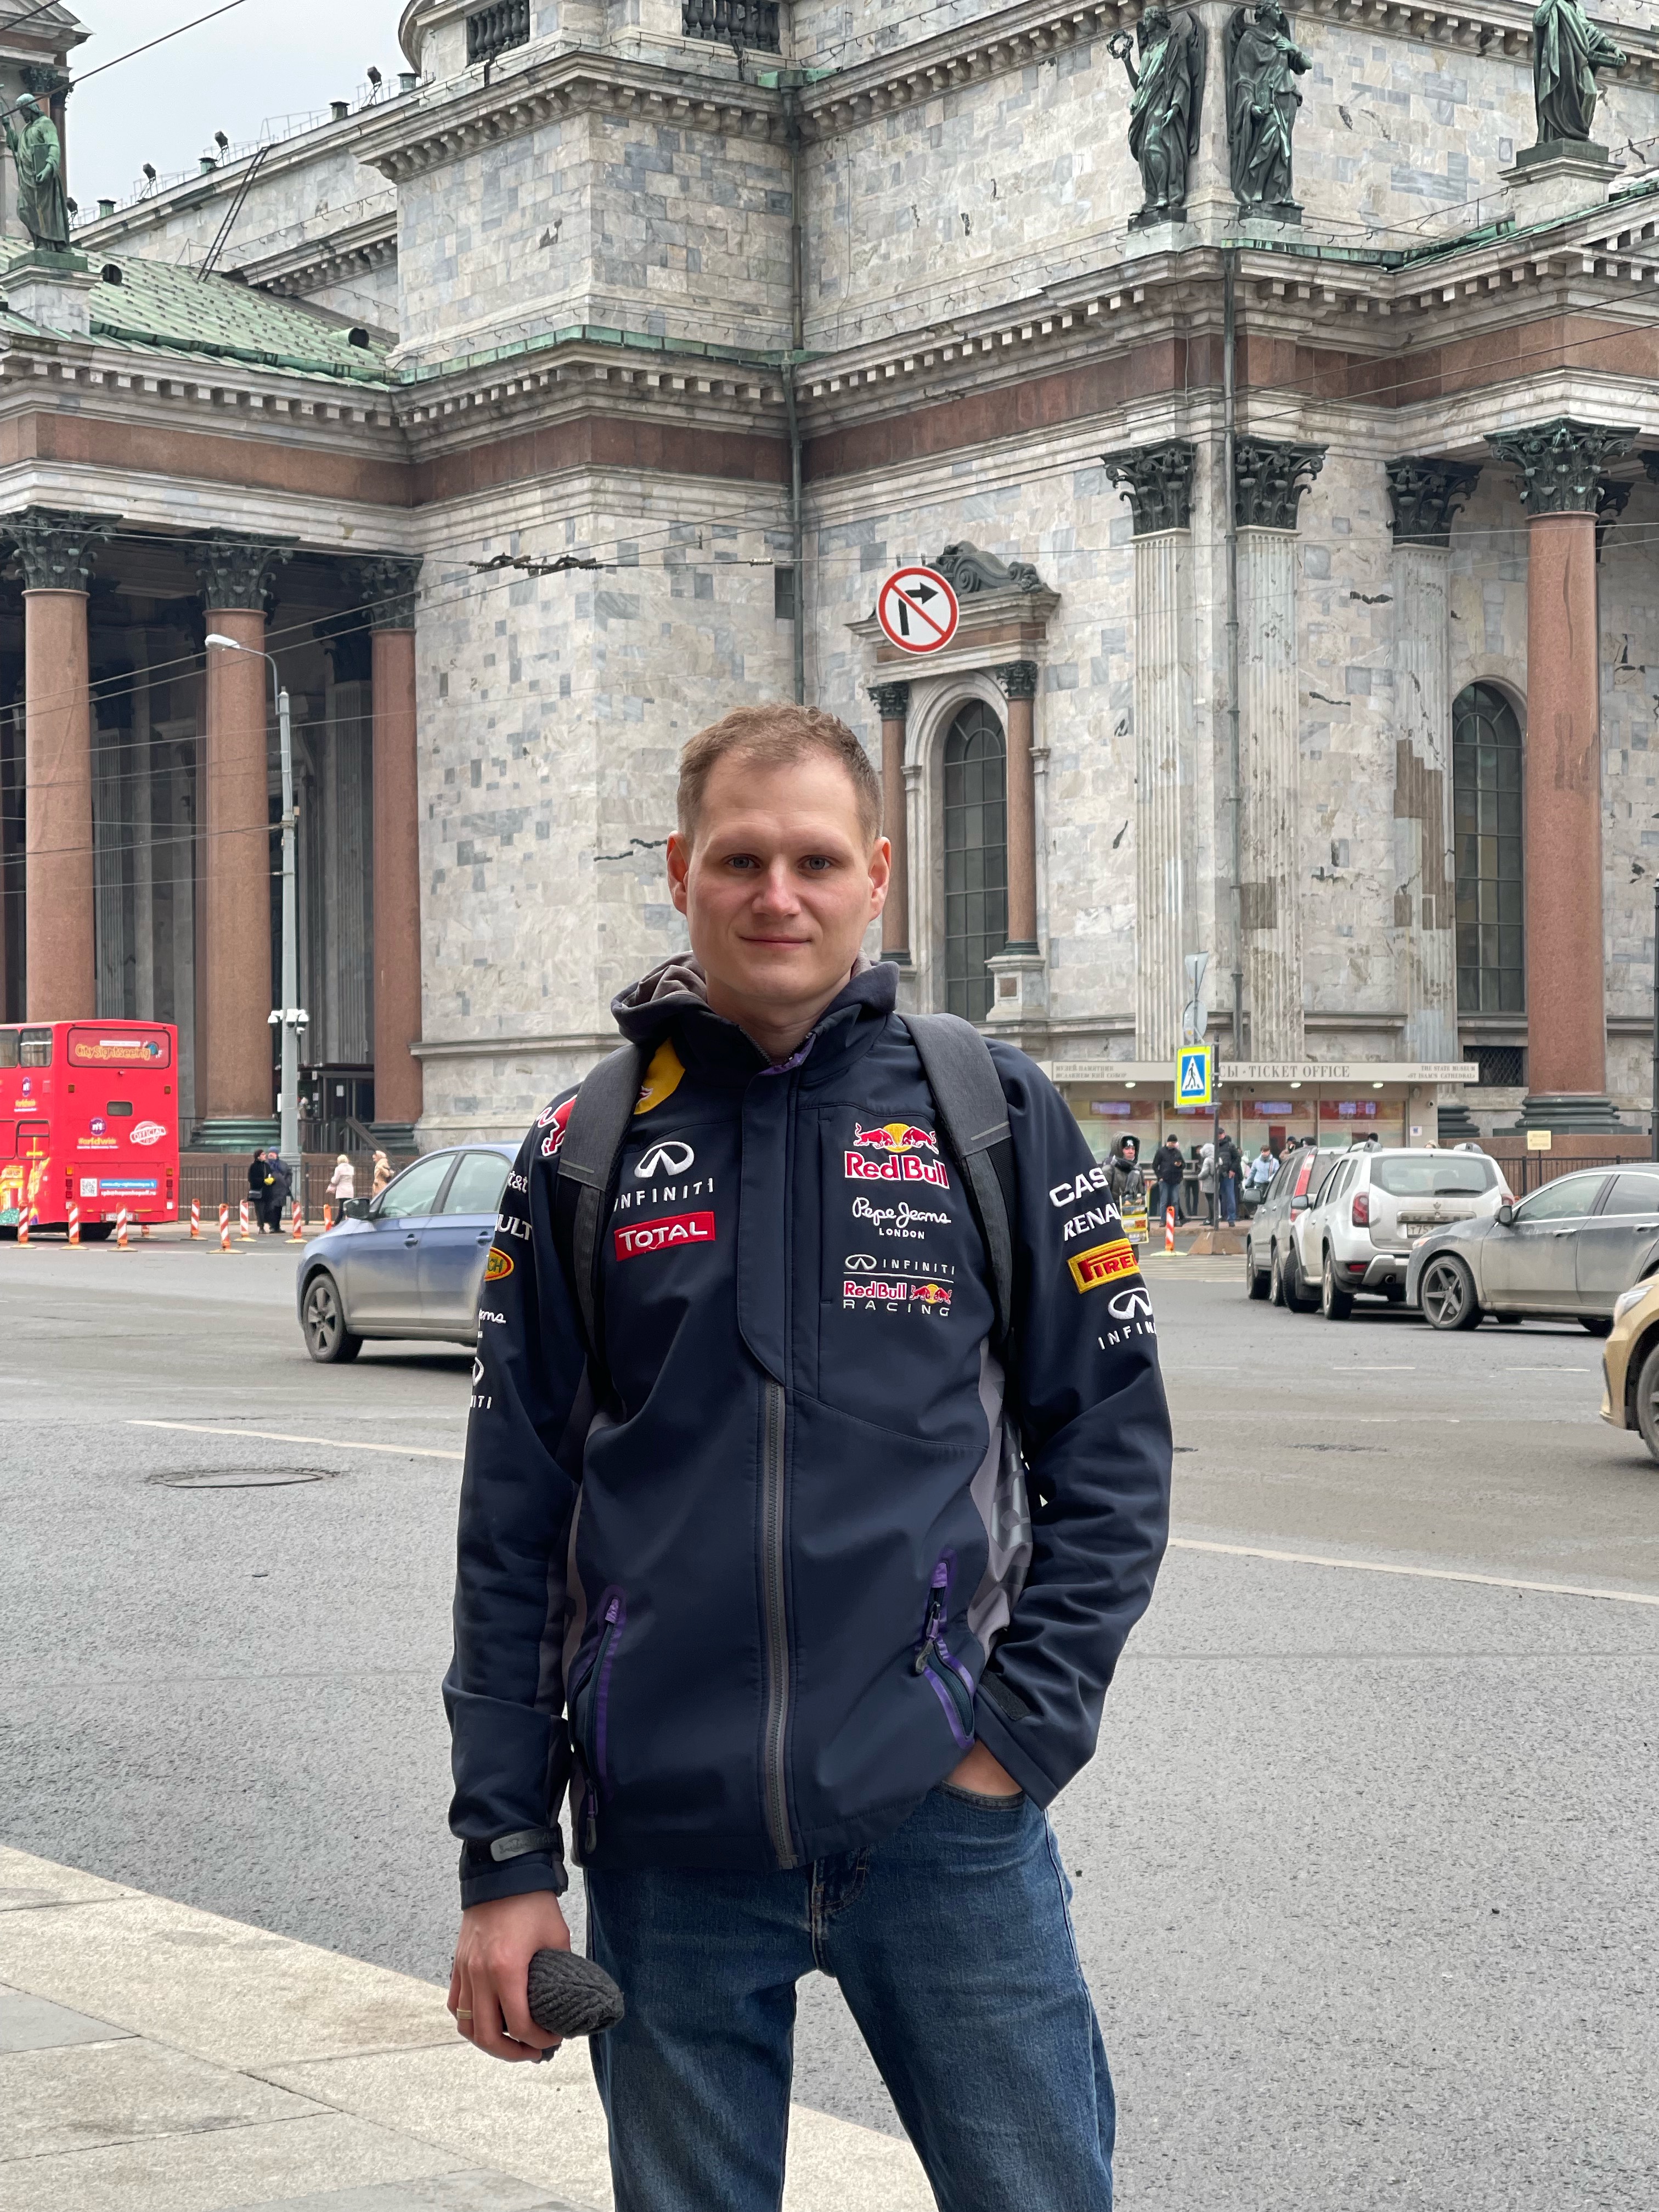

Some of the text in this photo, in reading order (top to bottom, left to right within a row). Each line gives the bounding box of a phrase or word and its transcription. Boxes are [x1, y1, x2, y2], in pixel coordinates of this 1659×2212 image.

[1249, 1065, 1350, 1078] TICKET OFFICE
[613, 1177, 713, 1212] INFINITI
[1049, 1167, 1108, 1207] CAS
[853, 1197, 951, 1228] Pepe Jeans
[1063, 1203, 1121, 1242] RENA
[495, 1214, 533, 1240] ULT
[619, 1222, 708, 1251] TOTAL
[879, 1227, 925, 1239] LONDON
[883, 1259, 955, 1275] INFINITI
[843, 1299, 950, 1317] RACING
